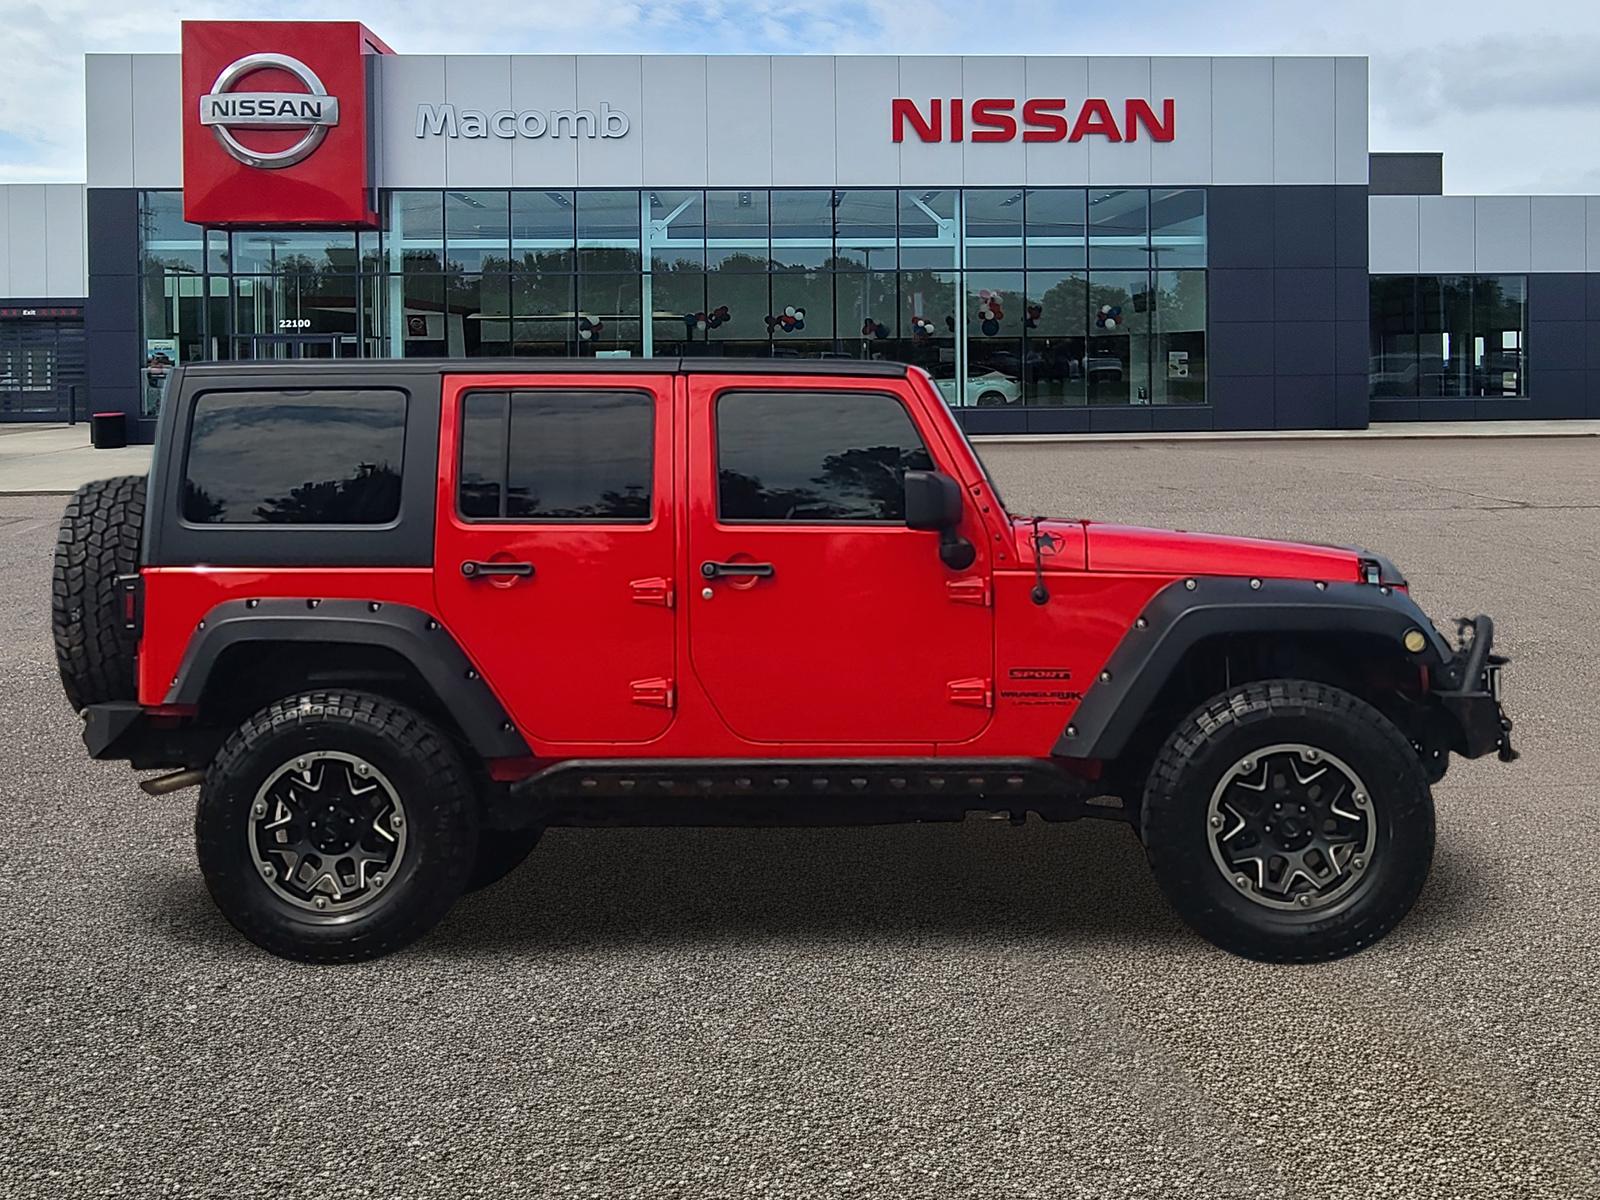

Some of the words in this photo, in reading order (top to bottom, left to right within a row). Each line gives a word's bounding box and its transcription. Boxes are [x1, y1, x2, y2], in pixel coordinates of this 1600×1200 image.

[212, 100, 322, 117] NISSAN
[415, 102, 631, 139] Macomb
[891, 98, 1176, 143] NISSAN
[279, 319, 311, 328] 22100
